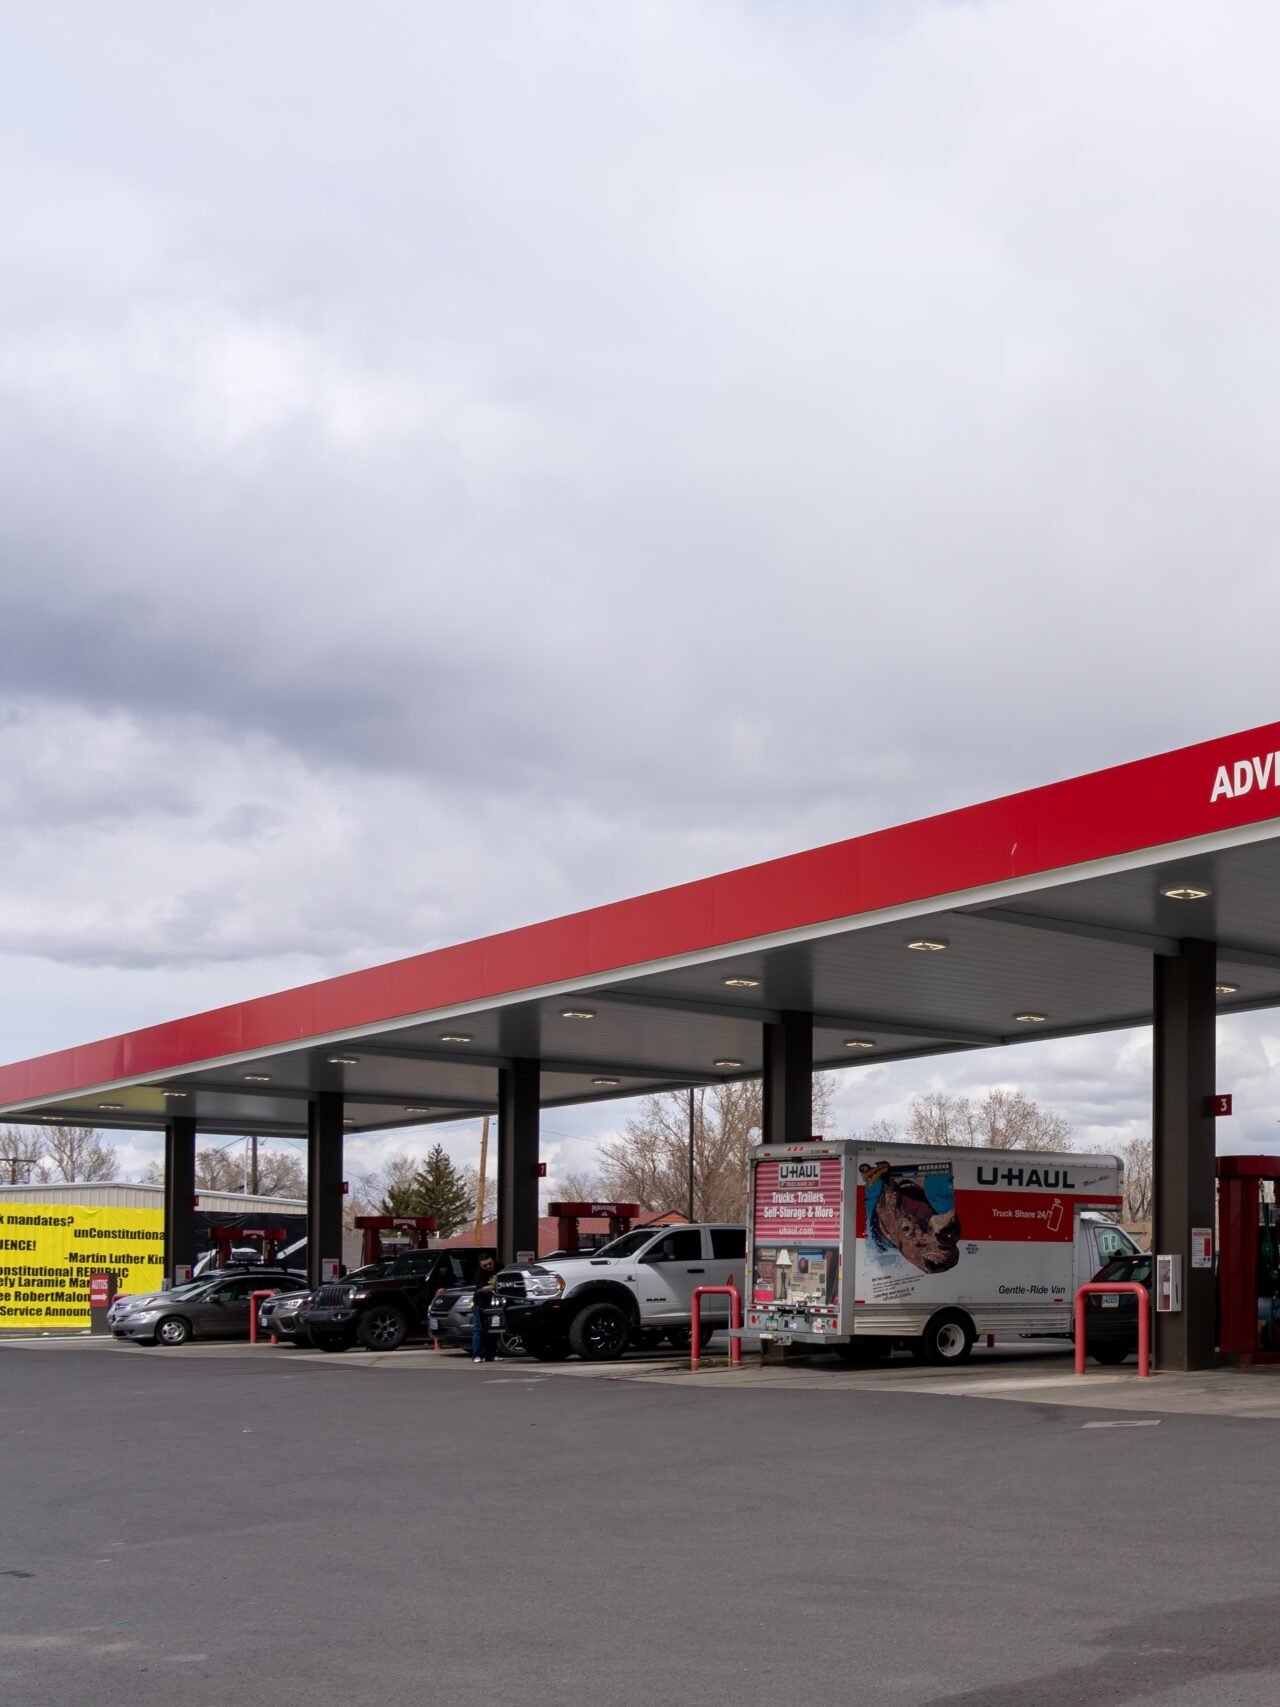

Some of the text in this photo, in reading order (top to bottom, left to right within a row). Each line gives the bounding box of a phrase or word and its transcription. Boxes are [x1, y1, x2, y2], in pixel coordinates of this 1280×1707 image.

[1220, 1098, 1228, 1112] 3
[780, 1165, 819, 1179] U-HAUL
[976, 1166, 1075, 1189] U-HAUL
[772, 1191, 826, 1205] Trucks, Trailers,
[763, 1206, 834, 1220] Self-Storage & More
[992, 1208, 1014, 1217] Truck
[1014, 1209, 1036, 1218] Share
[7, 1214, 74, 1227] mandates?
[64, 1252, 107, 1264] -Martin
[109, 1253, 145, 1265] Luther
[18, 1277, 66, 1288] Laramie
[91, 1279, 108, 1290] AUTOS
[998, 1285, 1066, 1295] Gentle-Ride Van
[0, 1305, 43, 1316] Service
